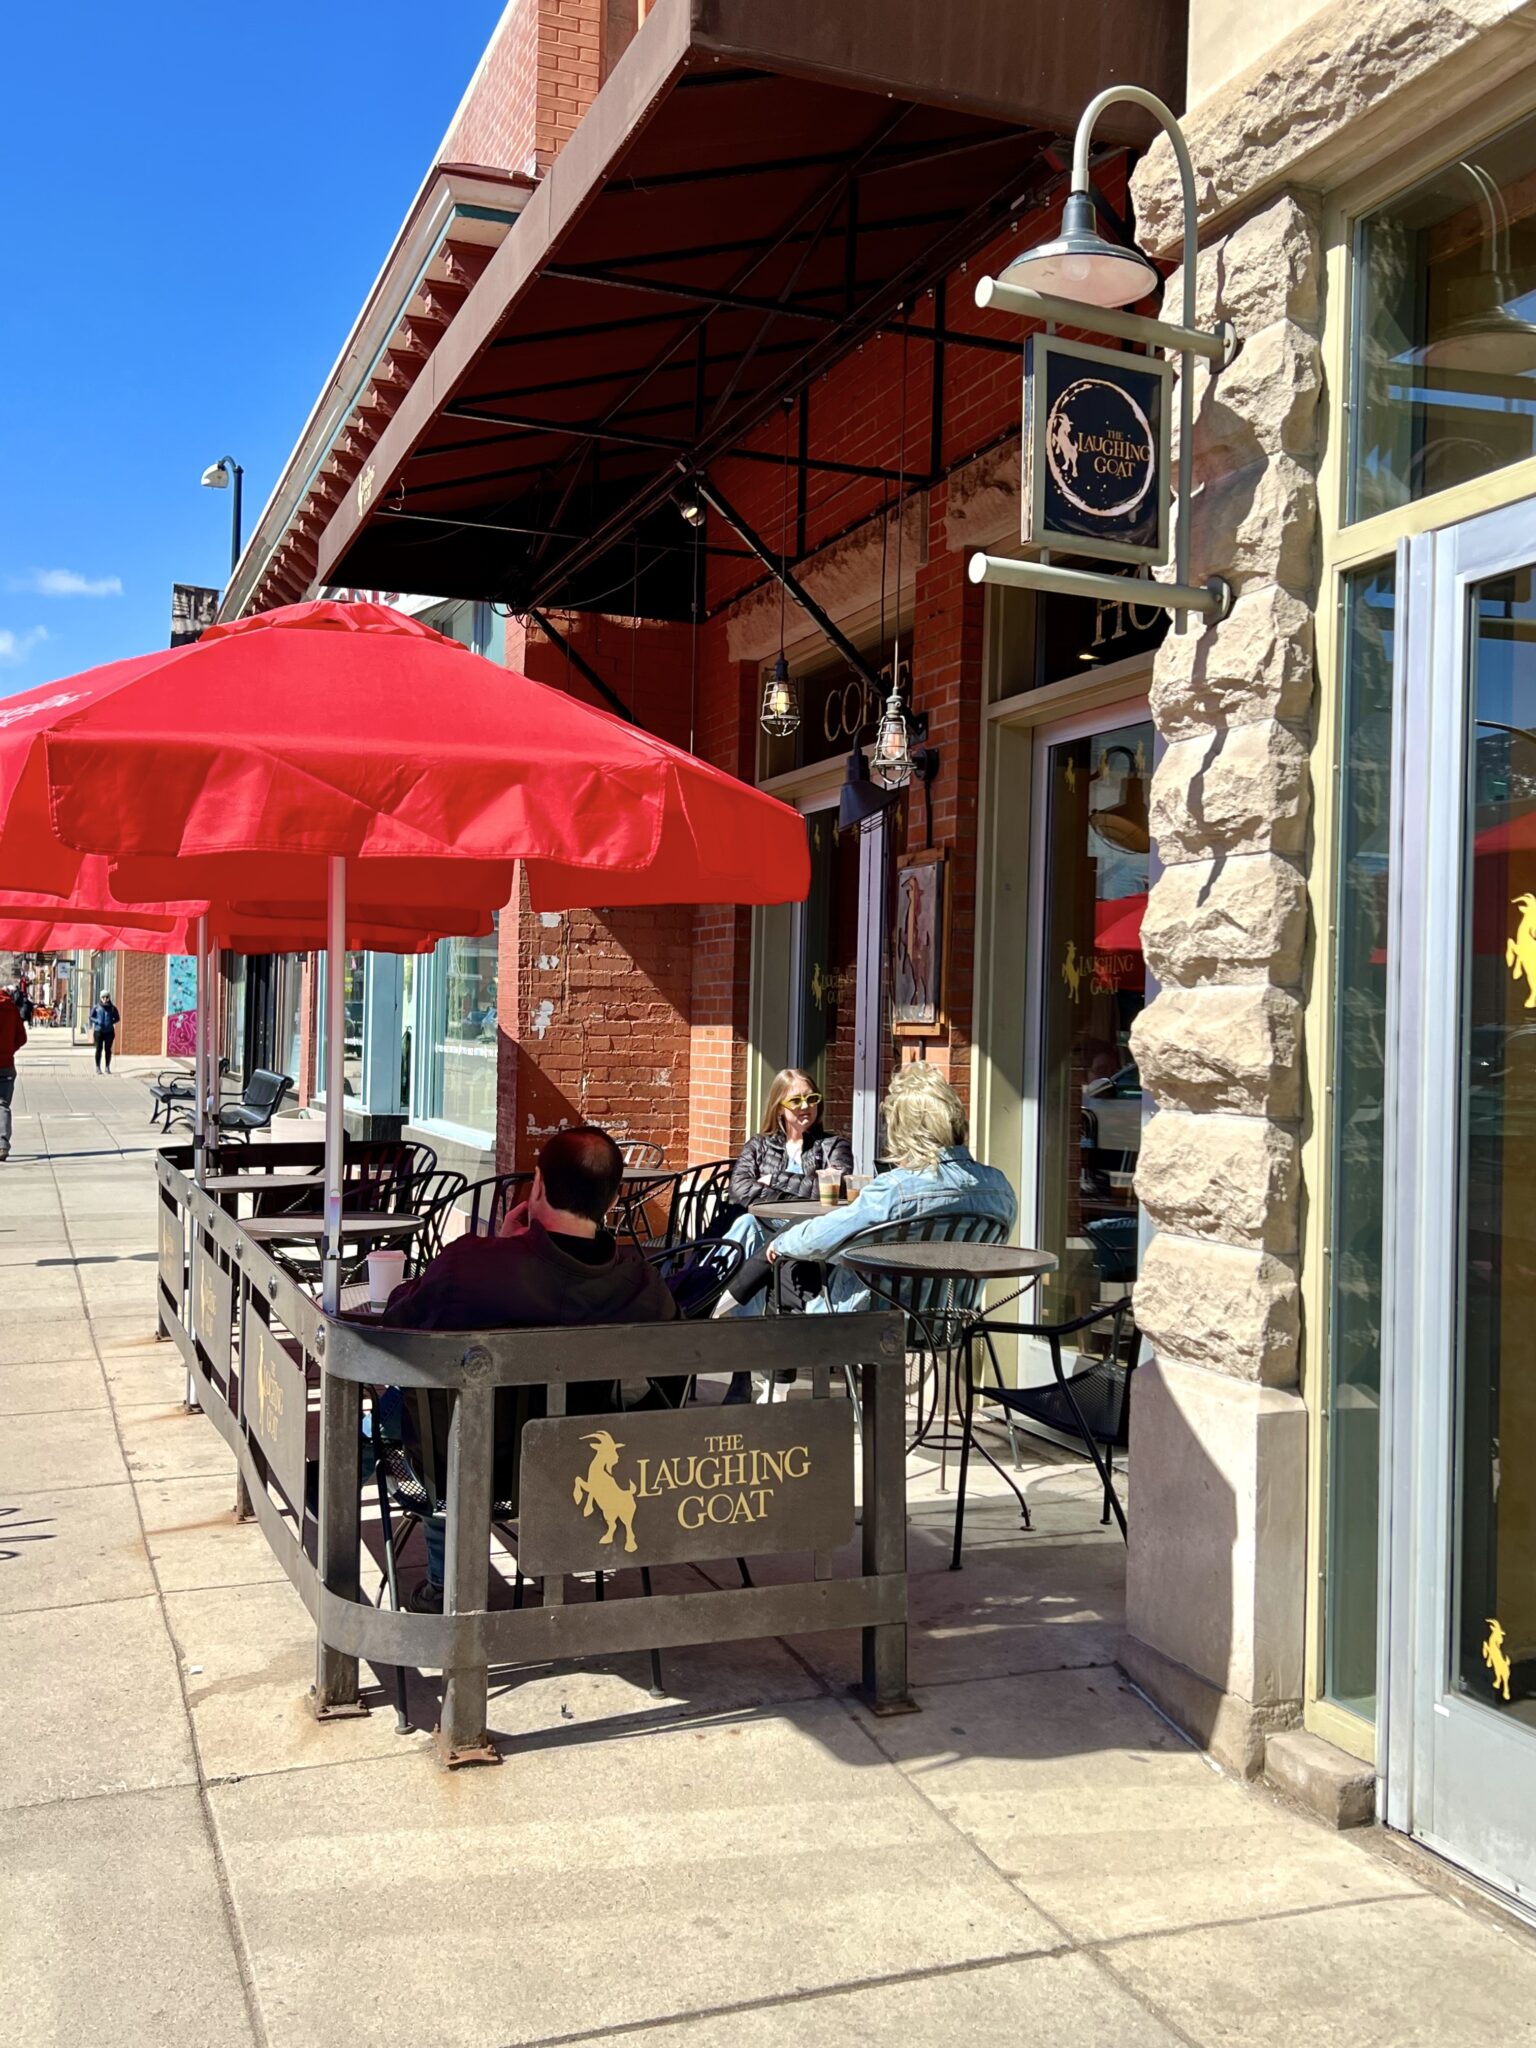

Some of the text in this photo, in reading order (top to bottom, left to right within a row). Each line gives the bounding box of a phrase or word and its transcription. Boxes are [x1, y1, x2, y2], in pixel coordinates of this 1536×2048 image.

[1078, 432, 1151, 461] LAUGHING
[1106, 429, 1124, 440] THE
[1094, 456, 1136, 477] GOAT
[705, 1434, 744, 1453] THE
[636, 1446, 812, 1498] LAUGHING
[677, 1489, 774, 1529] GOAT
